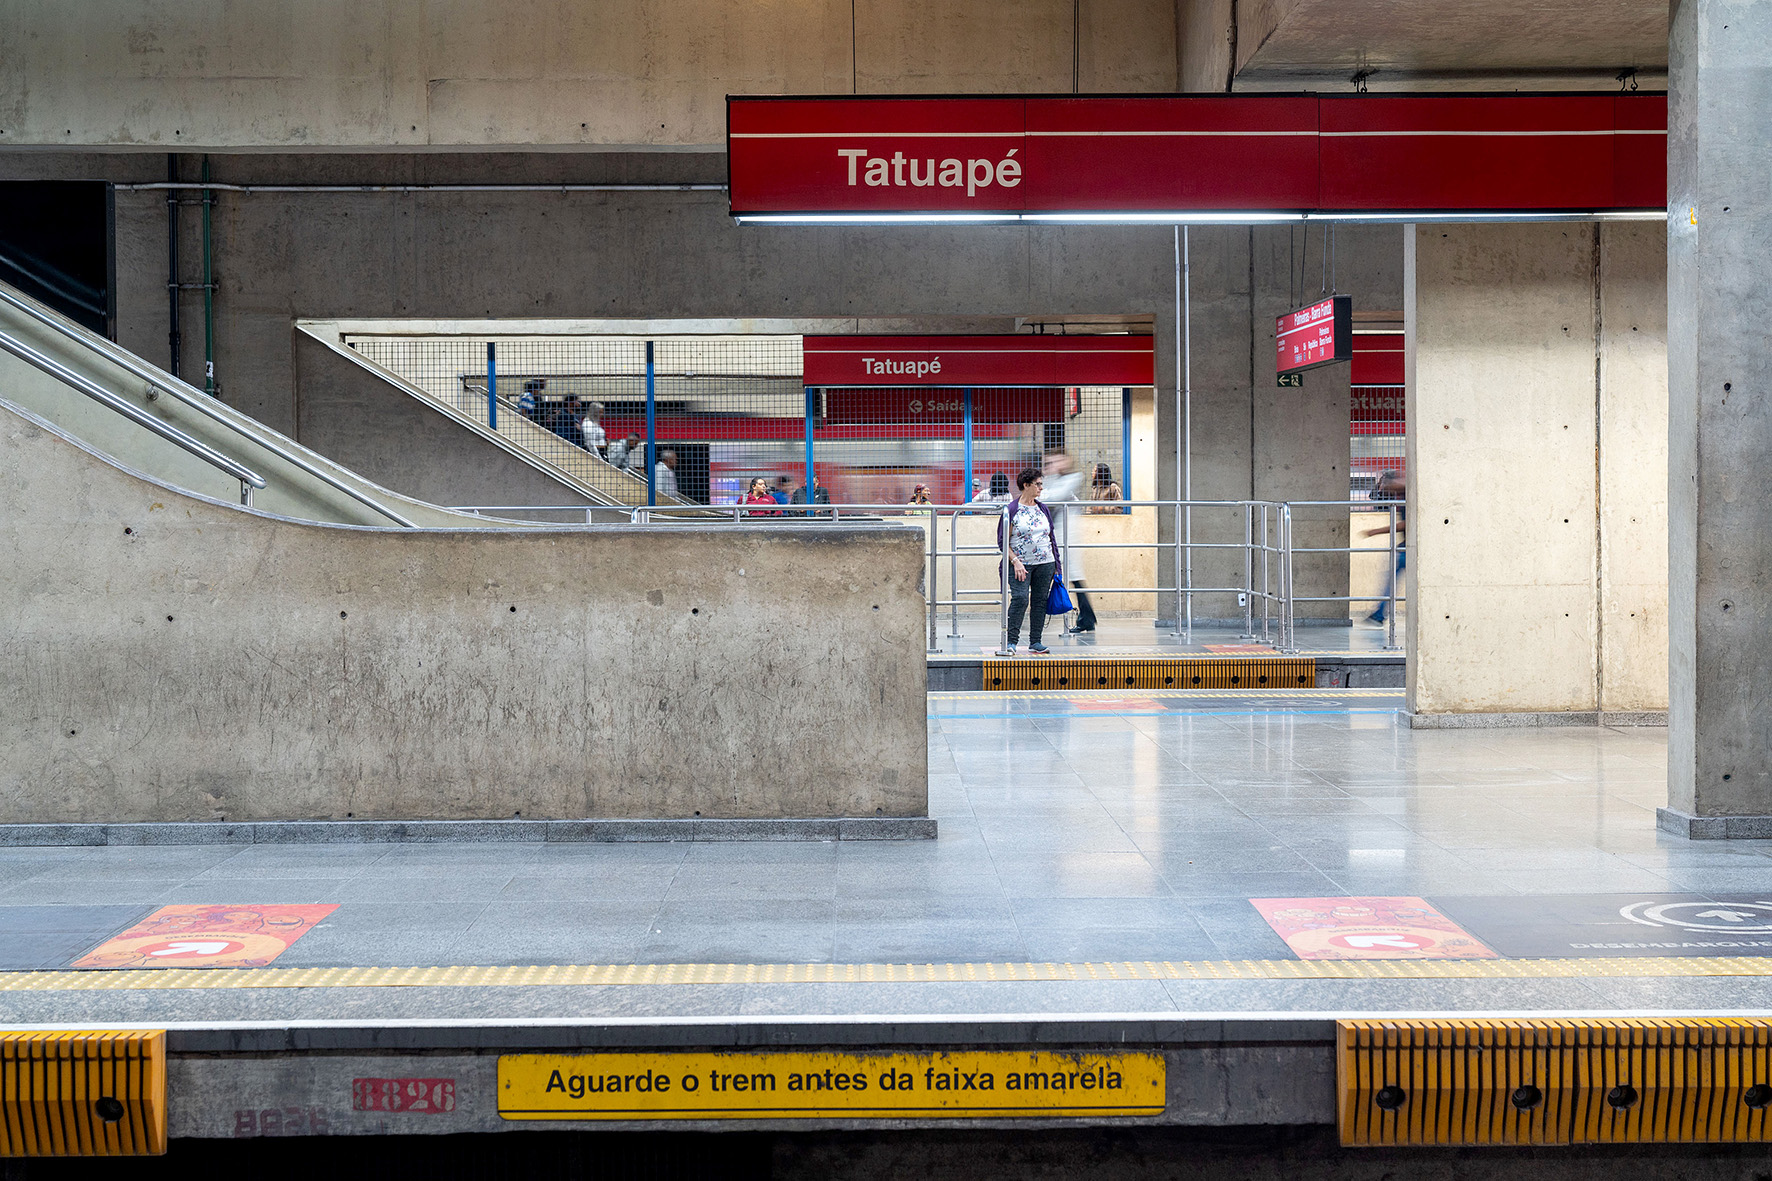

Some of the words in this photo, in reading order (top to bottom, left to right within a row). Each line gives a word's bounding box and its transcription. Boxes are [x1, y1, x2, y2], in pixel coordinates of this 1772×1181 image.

[838, 149, 1022, 197] Tatuapé
[862, 356, 941, 378] Tatuapé
[545, 1069, 671, 1099] Aguarde
[681, 1073, 700, 1092] o
[710, 1071, 776, 1092] trem
[787, 1069, 868, 1092] antes
[879, 1068, 914, 1091] da
[925, 1067, 995, 1091] faixa
[1006, 1067, 1123, 1091] amarela
